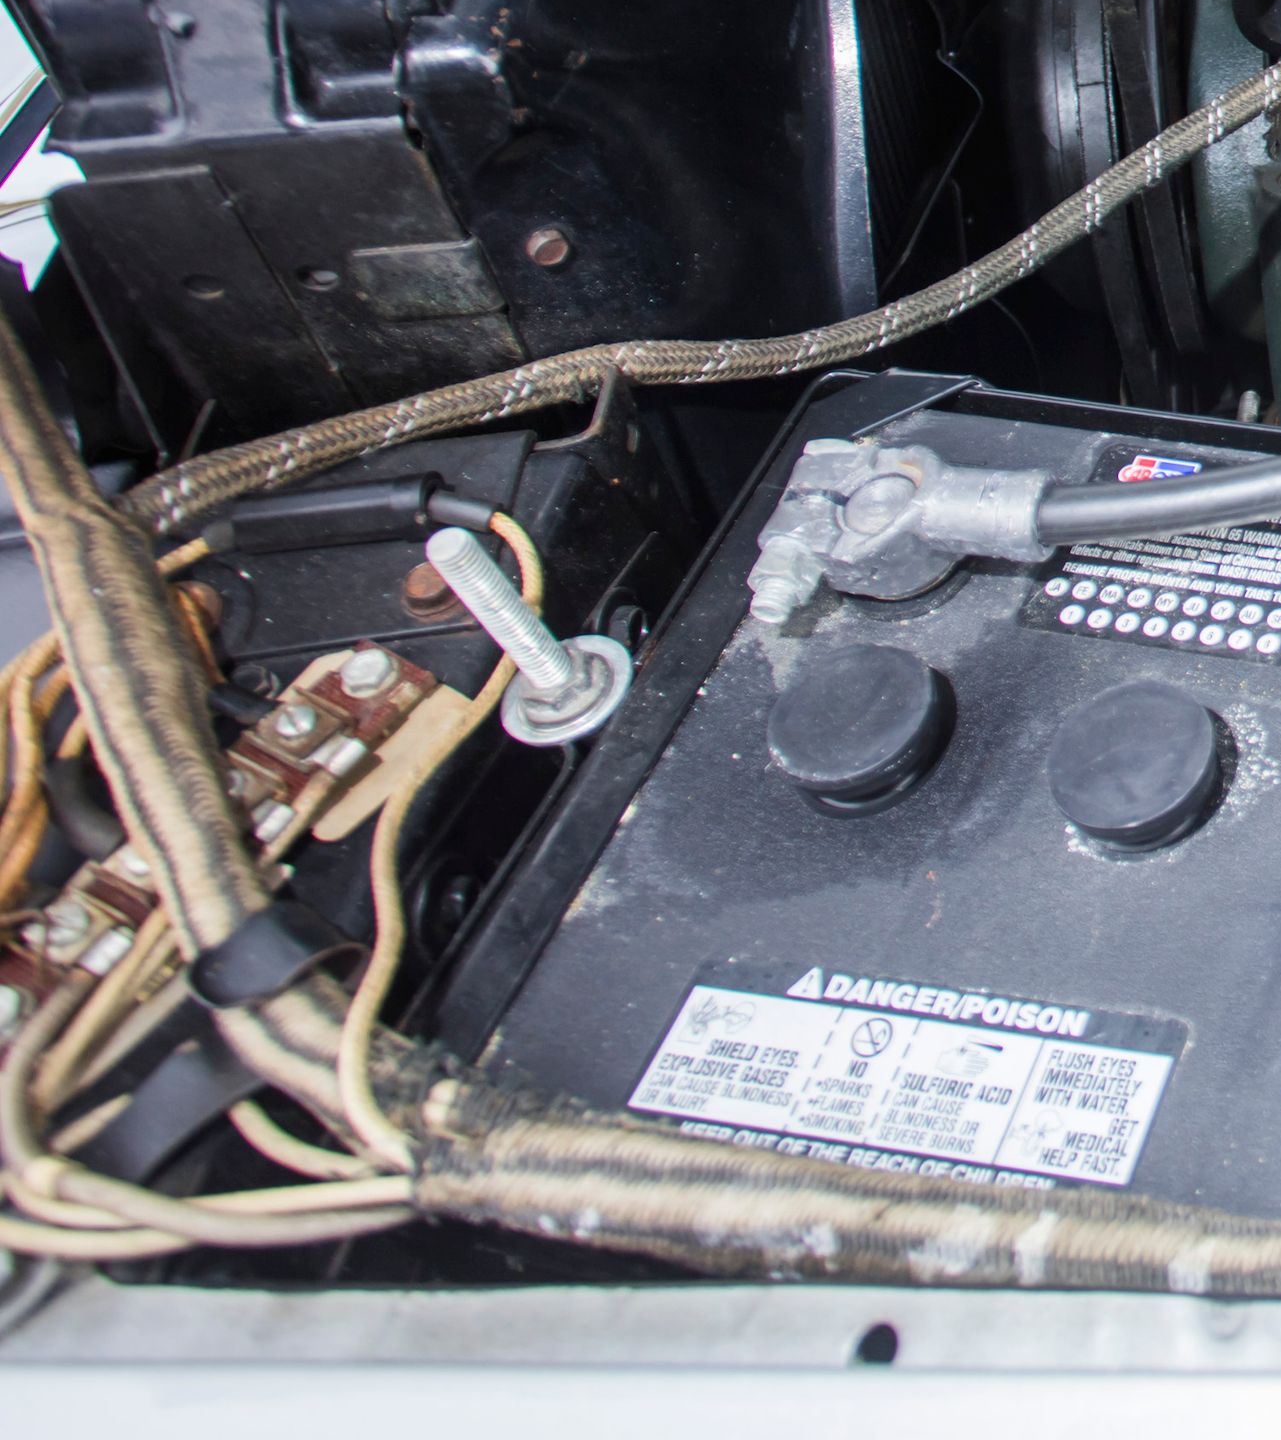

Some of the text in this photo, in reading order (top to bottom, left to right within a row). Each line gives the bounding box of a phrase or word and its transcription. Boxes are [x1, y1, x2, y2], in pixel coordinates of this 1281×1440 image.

[1170, 534, 1223, 551] accessories
[1221, 541, 1256, 556] contain
[1254, 546, 1277, 559] lead
[1226, 529, 1242, 542] 65
[1069, 543, 1103, 559] defects
[1101, 548, 1113, 560] or
[1111, 549, 1137, 564] other
[1216, 564, 1249, 579] WASH
[1142, 542, 1173, 556] known
[1171, 546, 1183, 558] to
[1182, 547, 1198, 560] the
[1197, 550, 1222, 563] State
[1220, 553, 1234, 565] of
[1231, 554, 1276, 571] California
[1061, 561, 1107, 578] REMOVE
[1104, 567, 1151, 584] PROPER
[1148, 573, 1191, 590] MONTH
[1188, 579, 1215, 593] AND
[1213, 582, 1245, 597] YEAR
[1243, 586, 1274, 601] TABS
[822, 971, 1092, 1040] DANGER/POISON
[704, 1037, 803, 1069] SHIELD EYES.
[1046, 1048, 1137, 1078] FLUSH EYES
[656, 1052, 789, 1089] EXPLOSIVE GASES
[844, 1059, 868, 1079] NO
[1039, 1066, 1142, 1098] IMMEDIATELY
[638, 1087, 660, 1104] OR
[647, 1070, 792, 1107] CAN CAUSE BLINDNESS
[890, 1091, 965, 1116] CAN CAUSE
[898, 1072, 1013, 1106] SULFURIC ACID
[1032, 1085, 1133, 1117] WITH WATER.
[883, 1108, 980, 1137] BLINDNESS OR
[1106, 1117, 1139, 1138] GET
[731, 1128, 779, 1151] OUT
[774, 1135, 810, 1156] OF
[804, 1140, 851, 1163] THE
[845, 1147, 917, 1174] REACH
[916, 1158, 952, 1179] OF
[875, 1124, 979, 1155] SEVERE BURNS.
[1061, 1130, 1132, 1158] MEDICAL
[1036, 1147, 1124, 1177] HELP FAST.
